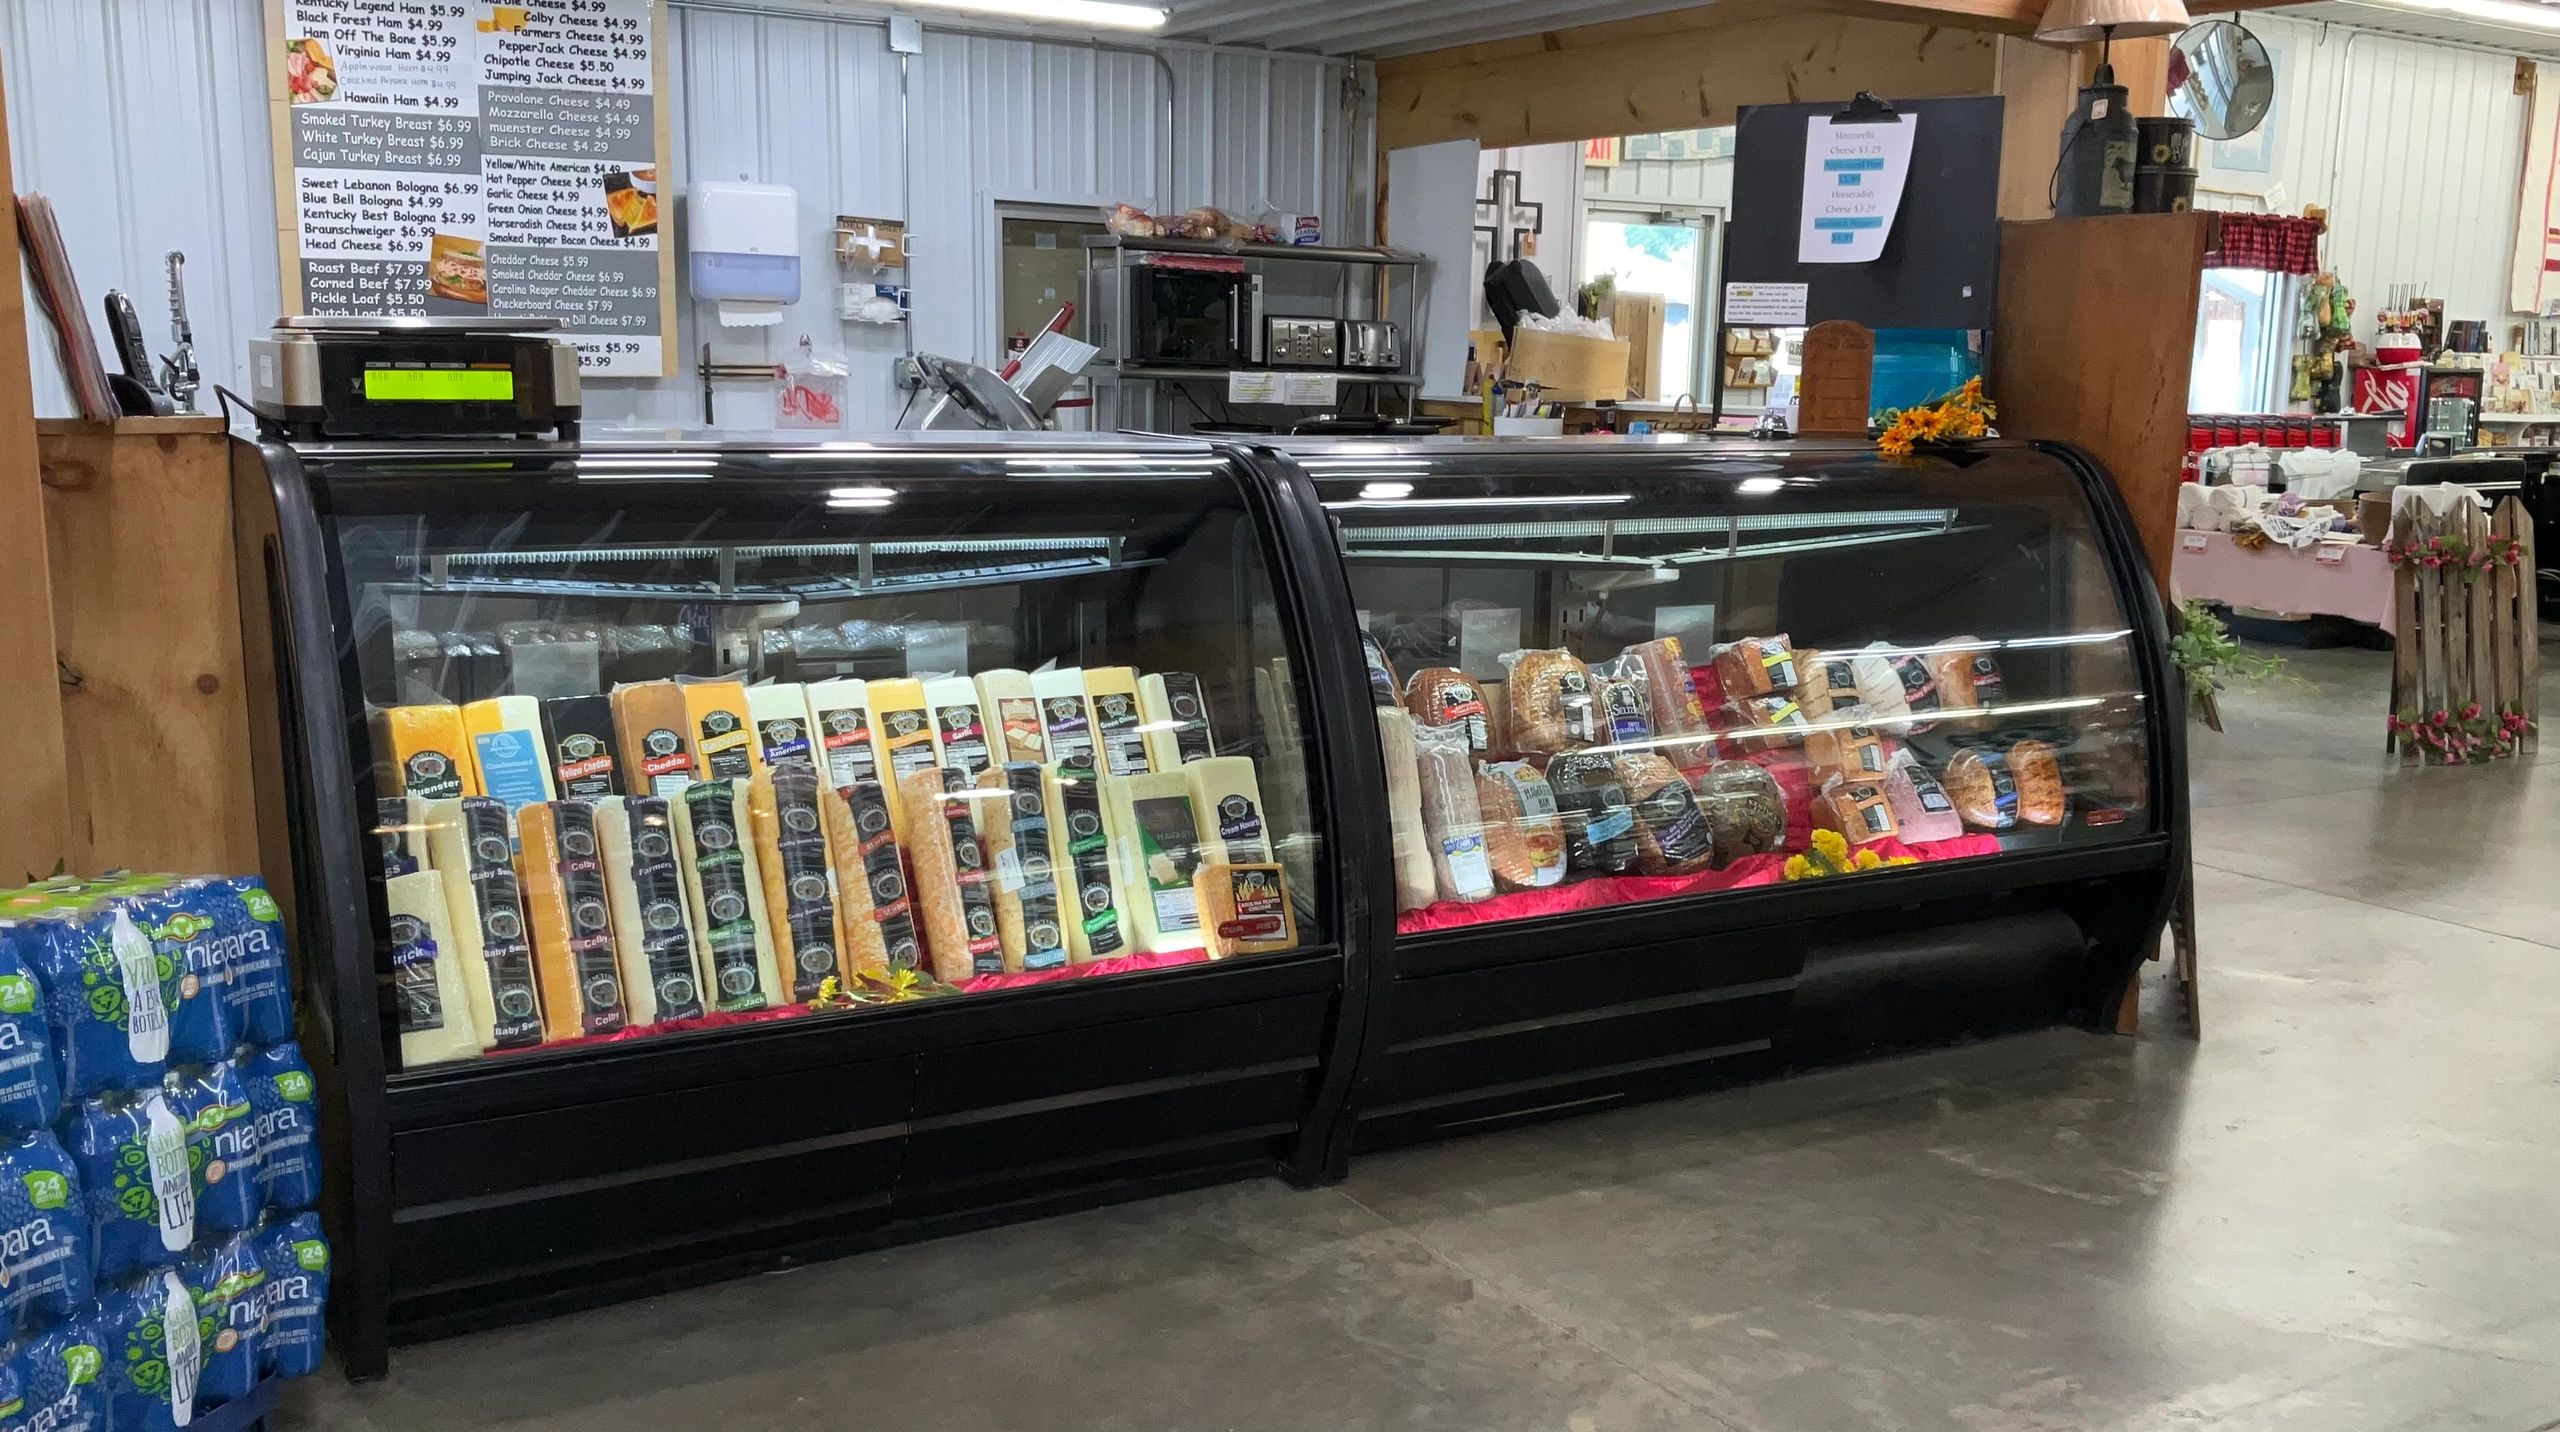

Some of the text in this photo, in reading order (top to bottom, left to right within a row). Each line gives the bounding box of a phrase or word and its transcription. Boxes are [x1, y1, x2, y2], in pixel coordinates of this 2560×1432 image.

[296, 0, 464, 17] Kentucky Legend Ham $5.99
[297, 10, 442, 31] Black Forest Ham $4.99
[524, 12, 637, 29] Colby Cheese $4.99
[303, 27, 456, 47] Ham Off The Bone $5.99
[514, 25, 643, 45] Farmers Cheese $4.99
[336, 44, 450, 62] Virginia Ham $4.99
[499, 40, 646, 60] PepperJack Cheese $4.99
[484, 54, 614, 72] Chipotle Cheese $5.50
[485, 69, 645, 89] Jumping Jack Cheese $4.99
[344, 92, 458, 108] Hawaiin Ham $4.99
[488, 92, 630, 110] Provolone Cheese $4.49
[301, 113, 471, 132] Smoked Turkey Breast $6.99
[489, 107, 640, 125] Mozzarella Cheese $4.49
[490, 122, 631, 139] muenster Cheese $4.99
[303, 148, 461, 166] Cajun Turkey Breast $6.99
[1830, 146, 1855, 154] Cheese
[485, 159, 545, 172] Yellow/White
[550, 162, 590, 173] American
[302, 178, 478, 194] Sweet Lebanon Bologna $6.99
[486, 174, 602, 188] Hot Pepper Cheese $4.99
[302, 193, 443, 208] Blue Bell Bologna $4.99
[487, 188, 579, 202] Garlic Cheese $4.99
[304, 208, 475, 224] Kentucky Best Bologna $2.99
[488, 204, 608, 217] Green Onion Cheese $4.99
[1826, 205, 1851, 213] Cheese
[305, 223, 435, 238] Braunschweiger $6.99
[488, 217, 607, 231] Horseradish Cheese $4.99
[306, 239, 423, 252] Head Cheese $6.99
[489, 233, 650, 248] Smoked Pepper Bacon Cheese $4.99
[491, 254, 589, 266] Cheddar Cheese $5.99
[309, 262, 423, 276] Roast Beef $7.99
[492, 269, 624, 282] Smoked Cheddar Cheese $6.99
[310, 278, 432, 291] Corned Beef $7.99
[492, 284, 656, 298] Carolina Reaper Cheddar Cheese $6.99
[311, 292, 424, 306] Pickle Loaf $5.50
[493, 299, 612, 311] Checkerboard Cheese $7.99
[1050, 717, 1087, 732] Horseradish
[1100, 715, 1137, 729] Green Onion
[842, 731, 866, 743] Pepper
[952, 728, 972, 740] Garlic
[770, 743, 805, 758] American
[560, 758, 611, 778] Yellow Cheddar
[648, 757, 686, 772] Cheddar
[407, 779, 460, 797] Muenster
[1221, 824, 1239, 836] Cream
[571, 861, 595, 871] Colby
[639, 862, 672, 877] Farmers
[472, 869, 495, 881] Baby
[250, 895, 271, 910] 24
[584, 934, 608, 948] Colby
[651, 933, 685, 949] Farmers
[186, 929, 270, 971] niagara
[745, 996, 764, 1008] Jack
[595, 1011, 620, 1026] Colby
[495, 1025, 520, 1036] Baby
[284, 1075, 306, 1092] 24
[215, 1107, 298, 1156] niagara
[33, 1177, 60, 1193] 24
[303, 1246, 323, 1259] 24
[230, 1275, 309, 1326] niagara
